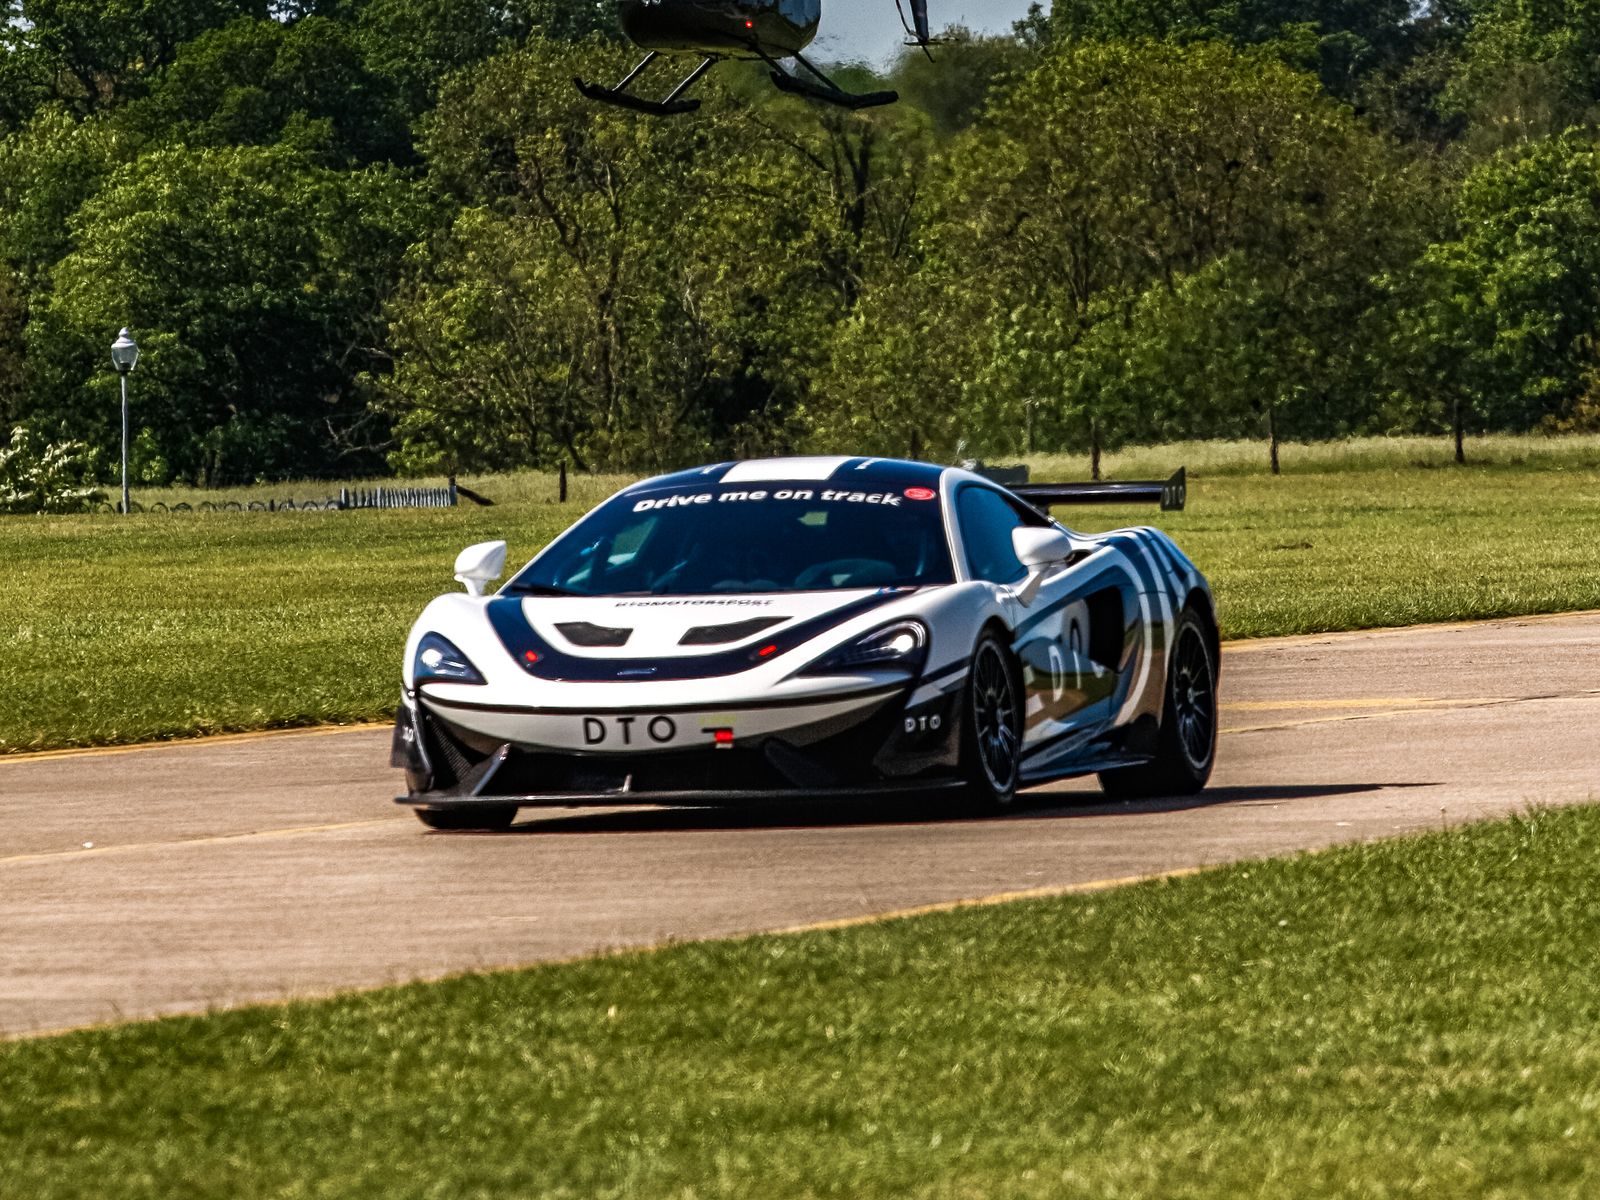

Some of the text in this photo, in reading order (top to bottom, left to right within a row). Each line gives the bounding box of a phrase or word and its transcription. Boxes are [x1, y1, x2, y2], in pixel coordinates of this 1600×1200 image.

[632, 489, 902, 512] Drive me on track
[583, 715, 677, 745] DTO
[904, 715, 941, 733] DTO
